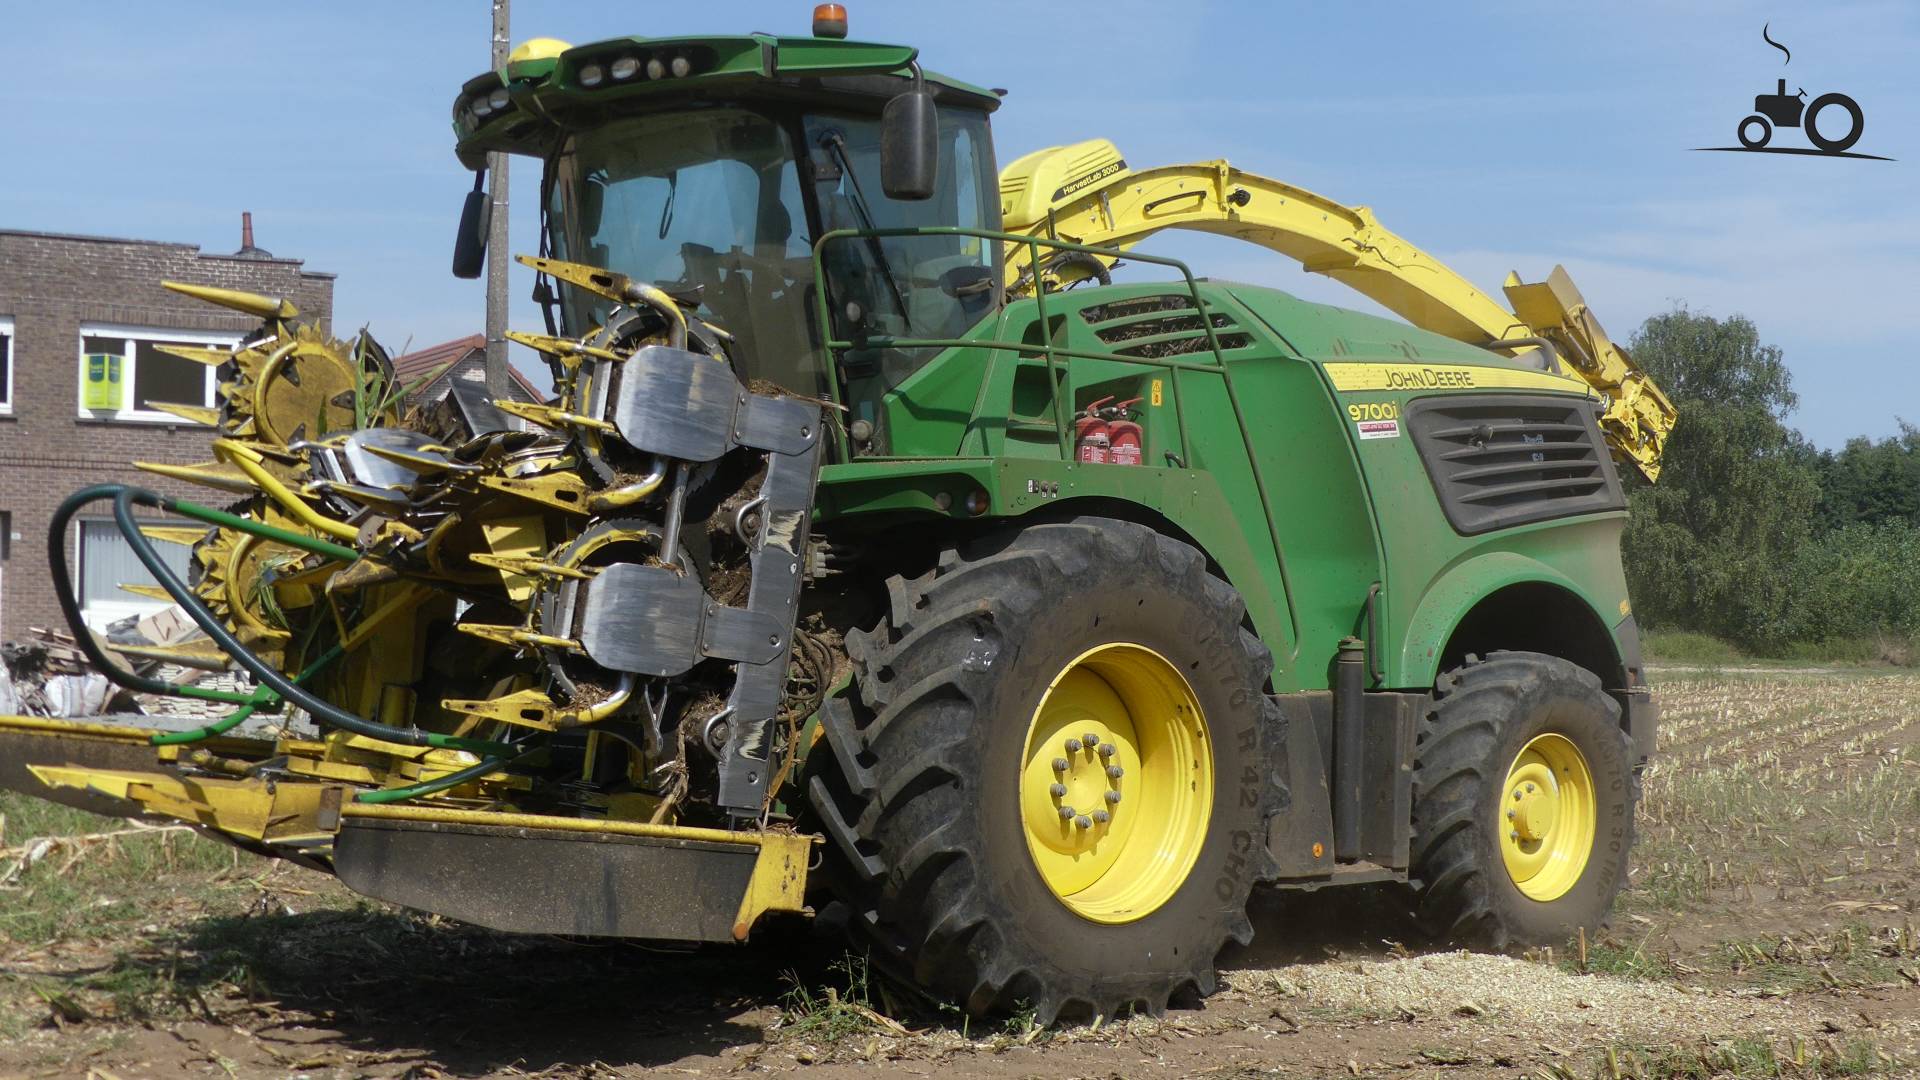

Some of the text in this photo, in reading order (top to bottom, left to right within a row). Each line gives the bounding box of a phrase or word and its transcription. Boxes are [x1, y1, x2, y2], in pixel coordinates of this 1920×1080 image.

[1063, 164, 1119, 195] HarvestLab 3000
[1385, 368, 1474, 387] JOHN DEERE
[1348, 401, 1398, 421] 9700i
[1237, 728, 1256, 750] R
[1239, 766, 1258, 808] 42
[1608, 826, 1624, 853] 30
